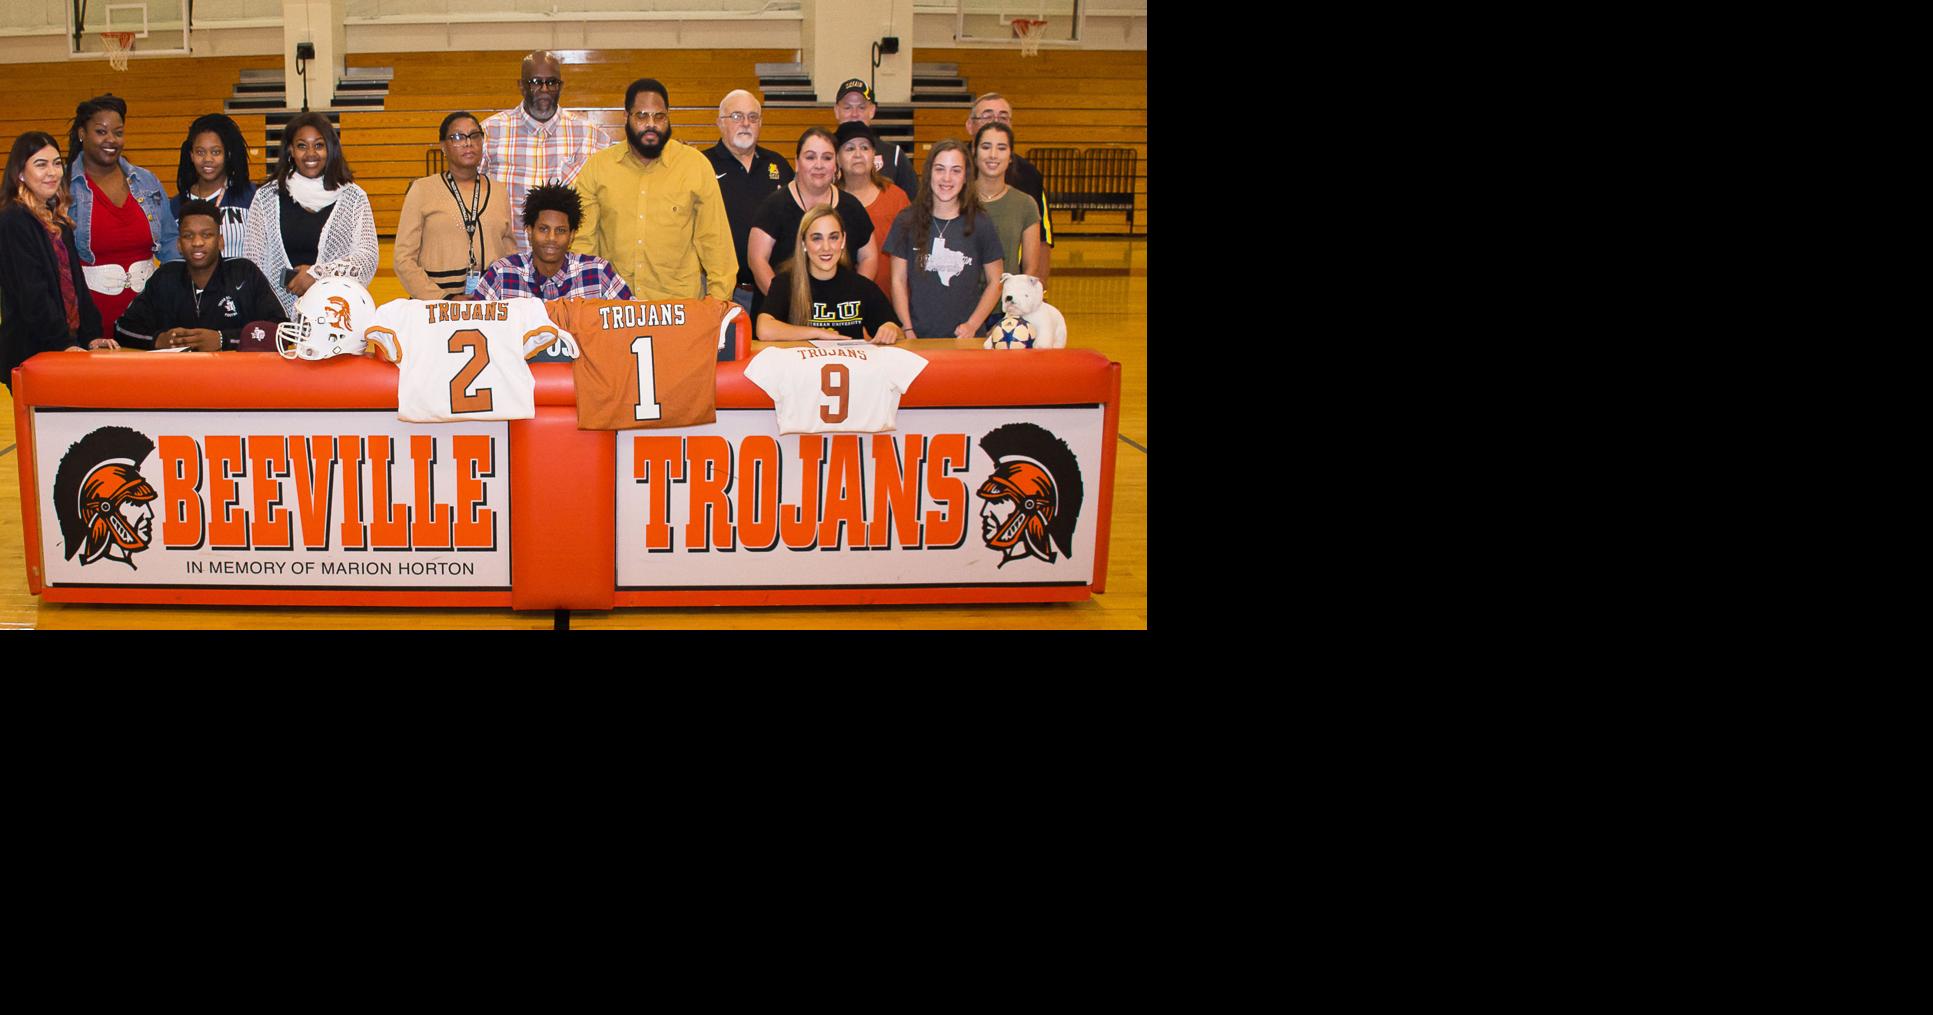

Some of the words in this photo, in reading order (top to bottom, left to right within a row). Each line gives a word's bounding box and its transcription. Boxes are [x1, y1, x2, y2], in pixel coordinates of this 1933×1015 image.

[426, 302, 509, 324] TROJANS
[599, 304, 686, 330] TROJANS
[813, 301, 862, 320] LU
[448, 329, 493, 414] 2
[797, 348, 867, 360] TROJANS
[630, 336, 662, 421] 1
[820, 363, 850, 424] 9
[158, 435, 498, 551] BEEVILLE
[633, 433, 971, 552] TROJANS
[186, 561, 203, 574] IN
[208, 561, 286, 575] MEMORY
[291, 562, 315, 575] OF
[321, 562, 392, 575] MARION
[399, 562, 475, 575] HORTON
